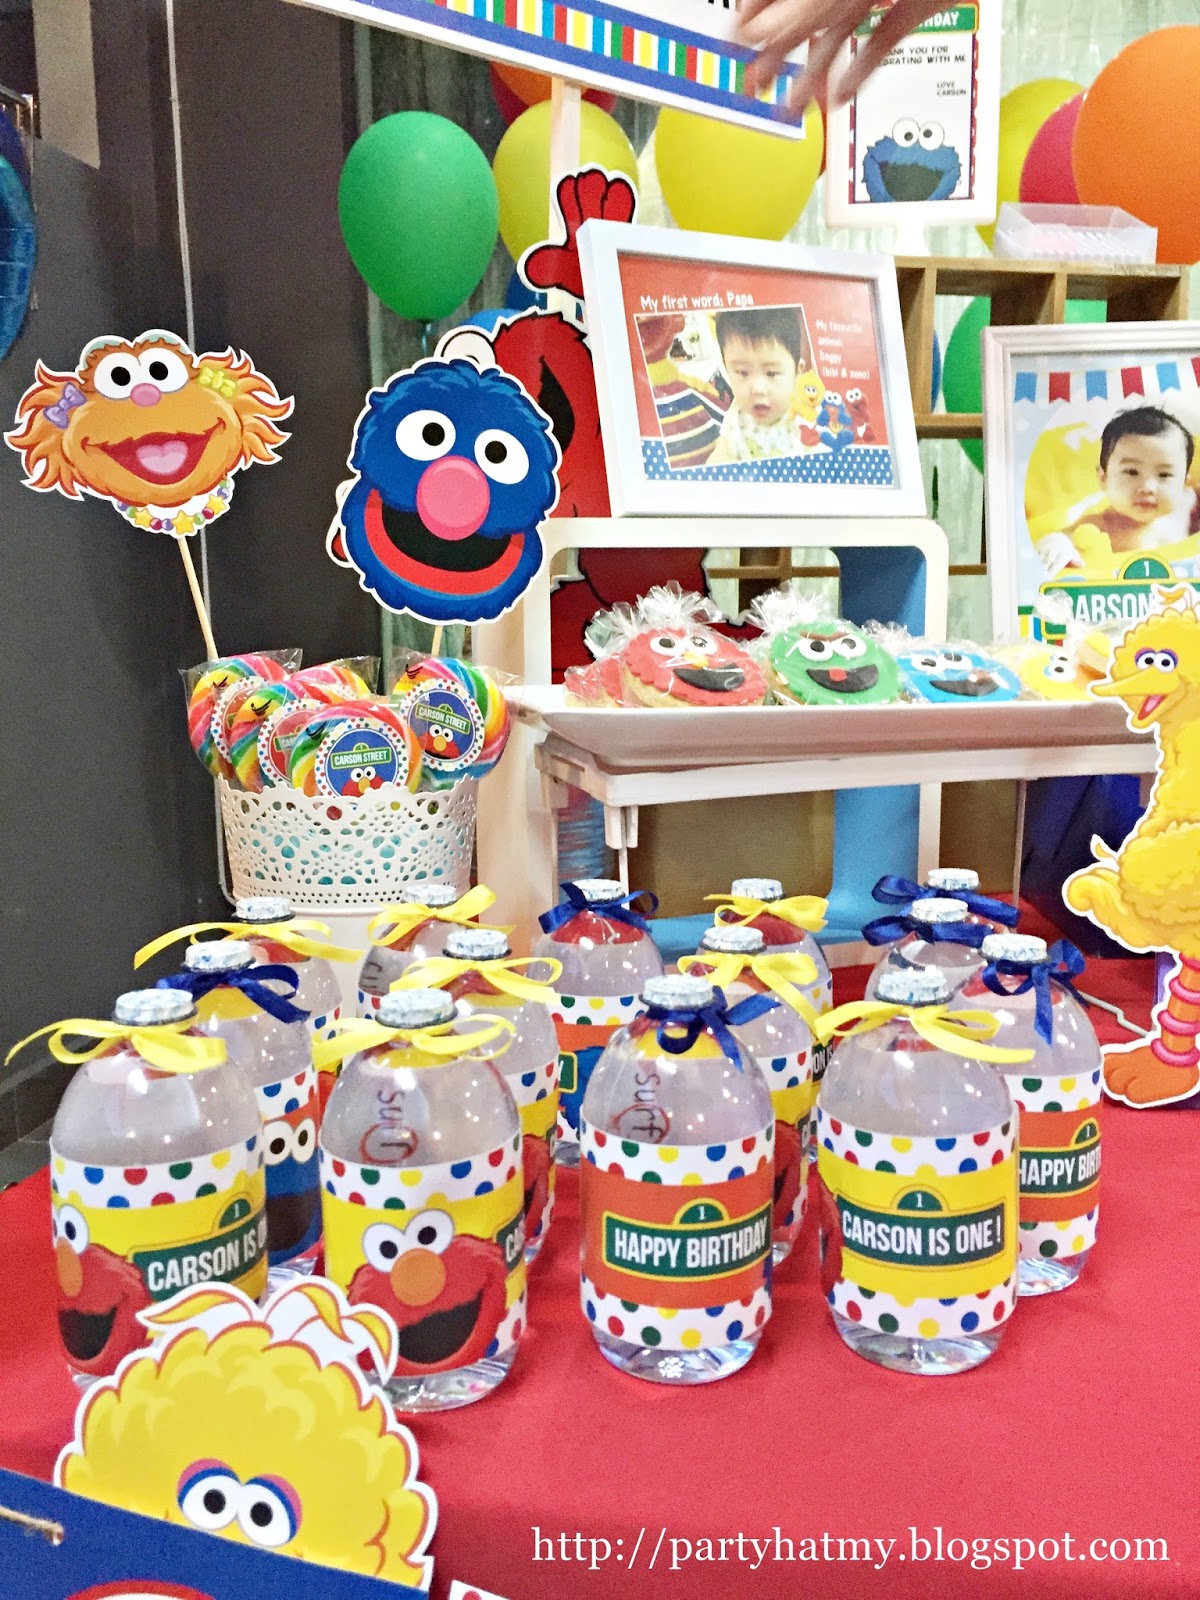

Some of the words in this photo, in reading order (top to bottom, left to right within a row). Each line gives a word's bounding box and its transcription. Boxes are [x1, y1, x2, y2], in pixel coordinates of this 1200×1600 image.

[909, 46, 928, 55] YOU
[931, 45, 949, 54] FOR
[927, 56, 951, 64] WITH
[954, 54, 966, 63] ME
[640, 295, 658, 313] My
[662, 294, 688, 310] first
[691, 292, 724, 308] word:
[726, 291, 754, 310] Papa
[815, 319, 827, 333] My
[1143, 560, 1150, 577] 1
[1075, 592, 1151, 623] ARSON
[419, 706, 445, 722] CARSON
[445, 713, 467, 731] STREET
[334, 752, 361, 766] CARSON
[362, 750, 388, 763] STREET
[1086, 1125, 1091, 1138] 1
[1019, 1157, 1076, 1187] HAPPY
[915, 1193, 924, 1208] 1
[233, 1203, 241, 1218] 1
[698, 1206, 706, 1221] 1
[842, 1210, 922, 1256] CARSON
[928, 1227, 951, 1256] IS
[614, 1227, 681, 1268] HAPPY
[686, 1216, 768, 1268] BIRTHDAY
[147, 1239, 240, 1292] CARSON
[243, 1229, 257, 1263] IS
